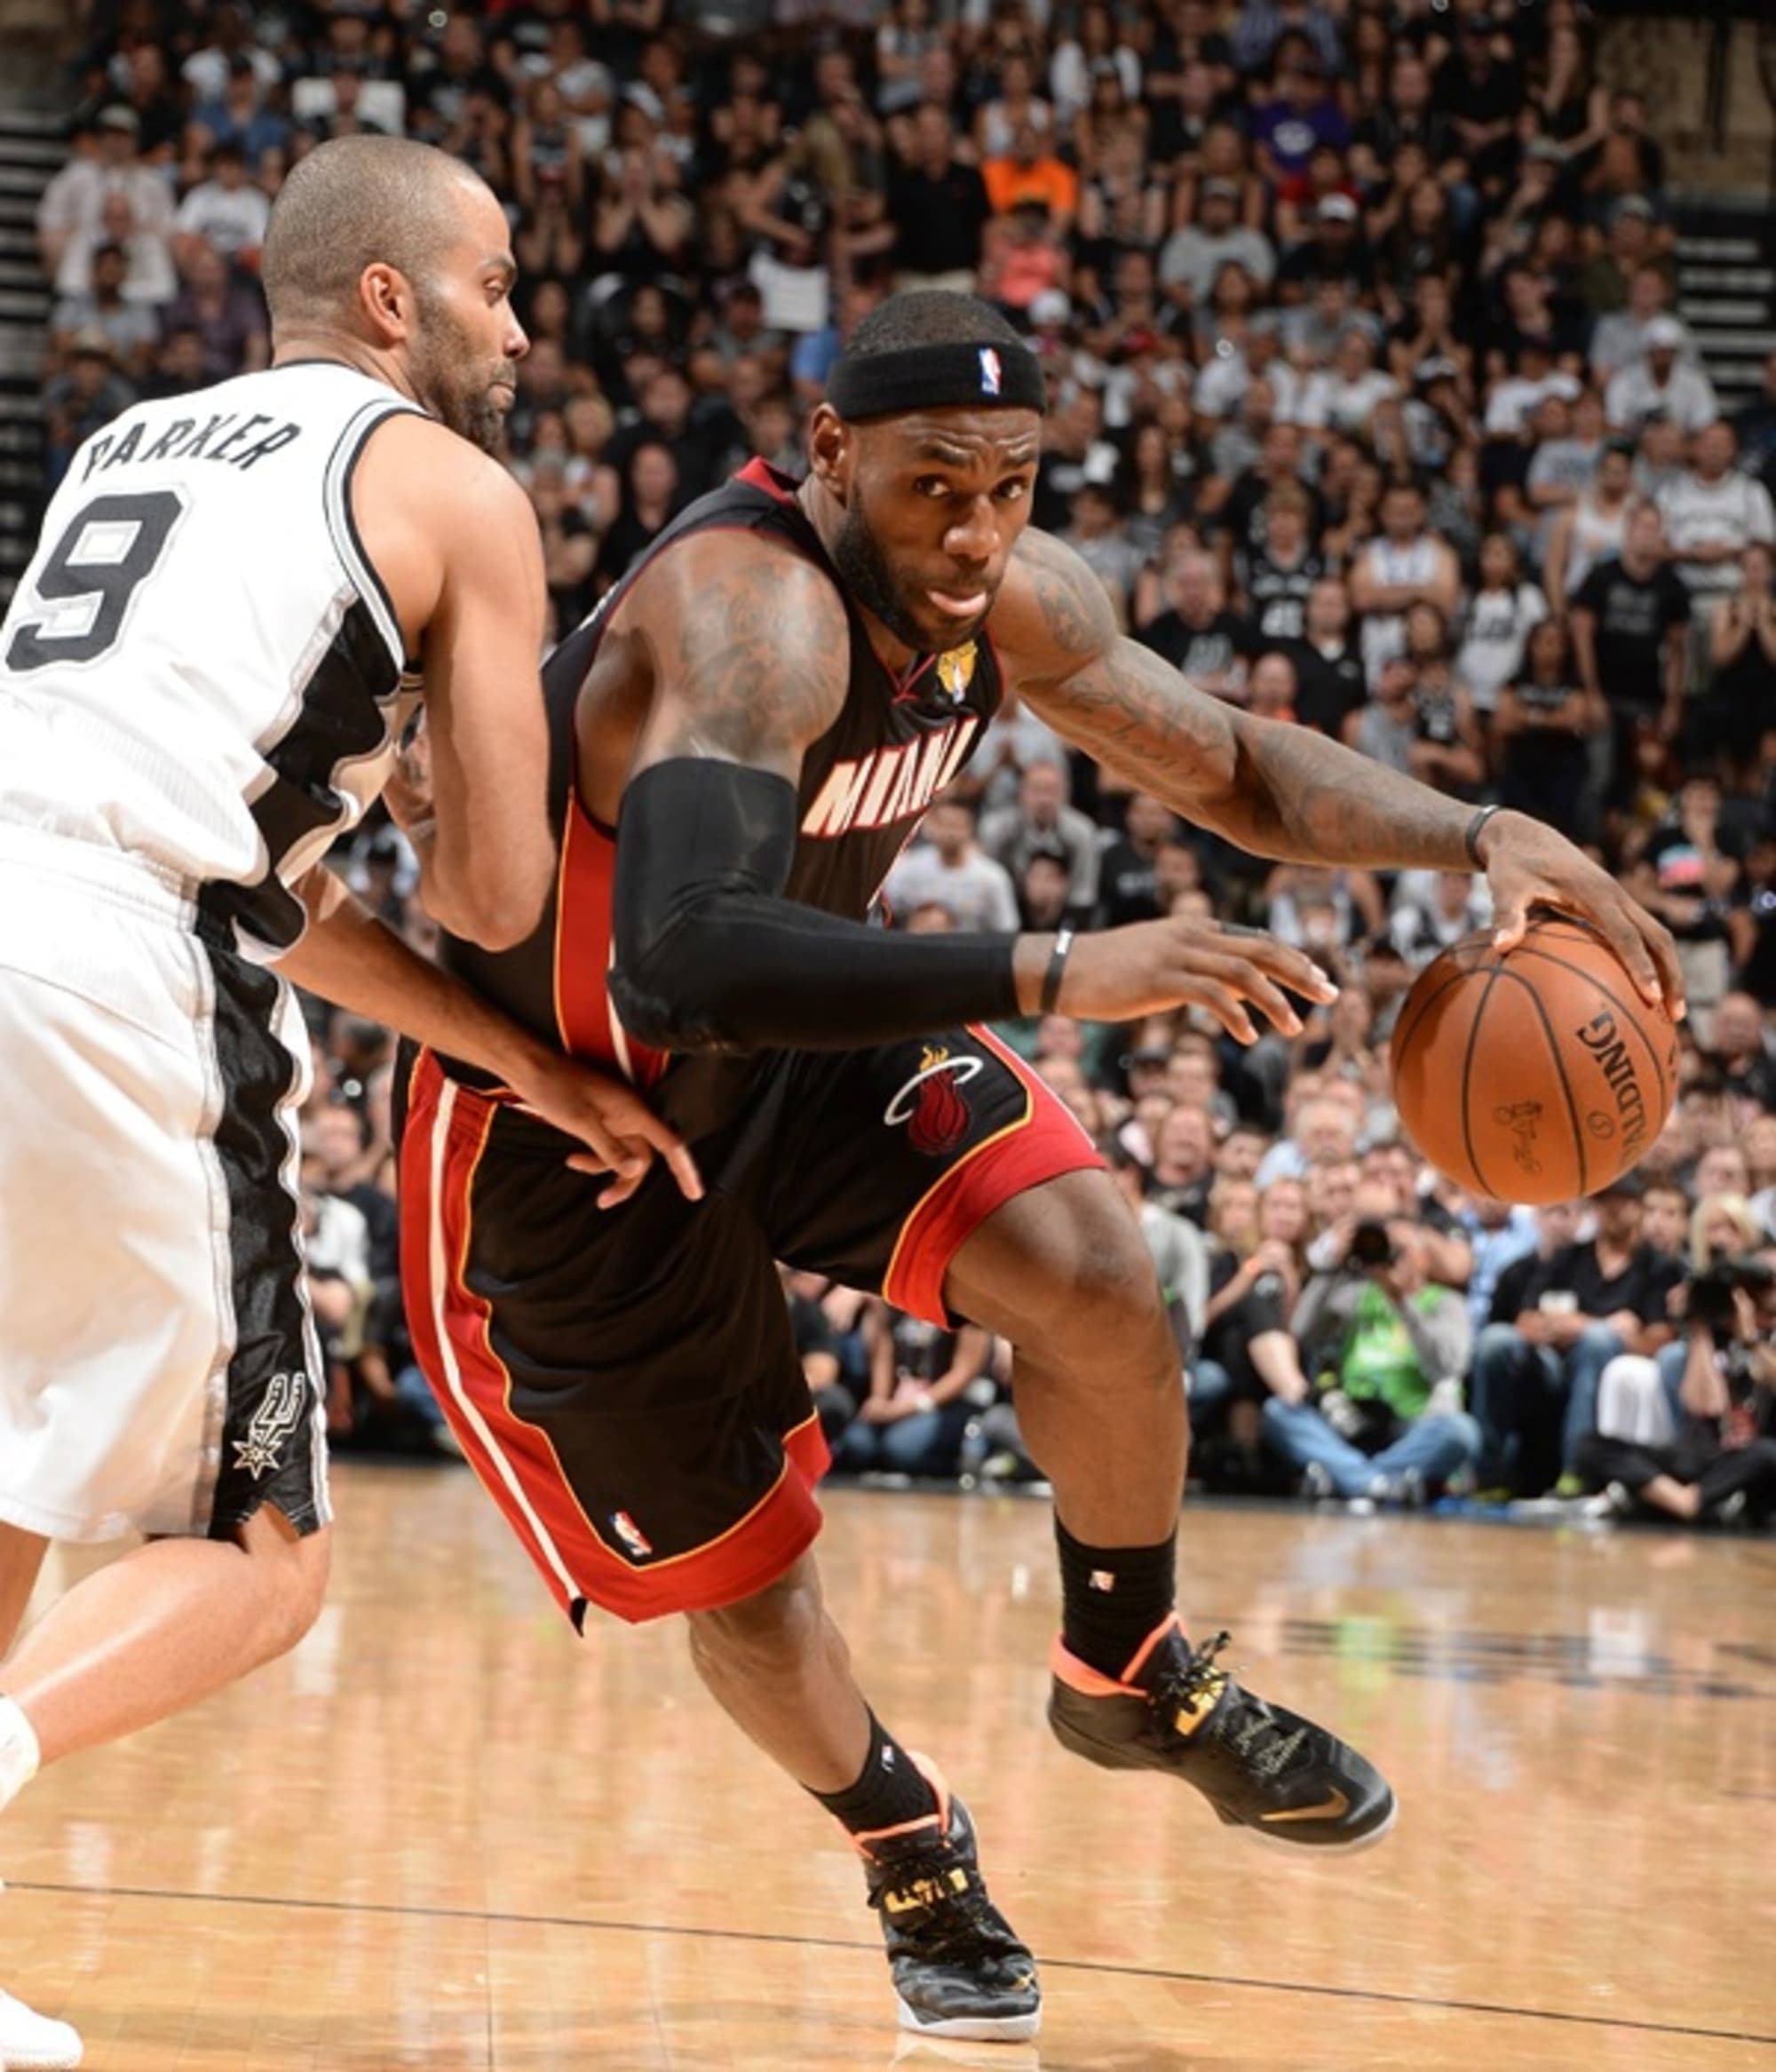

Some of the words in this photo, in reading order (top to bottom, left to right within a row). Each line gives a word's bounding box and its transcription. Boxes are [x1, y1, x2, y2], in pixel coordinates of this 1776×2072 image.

[81, 412, 302, 484] PARKER
[4, 488, 185, 674] 9
[799, 715, 979, 838] MIAMI
